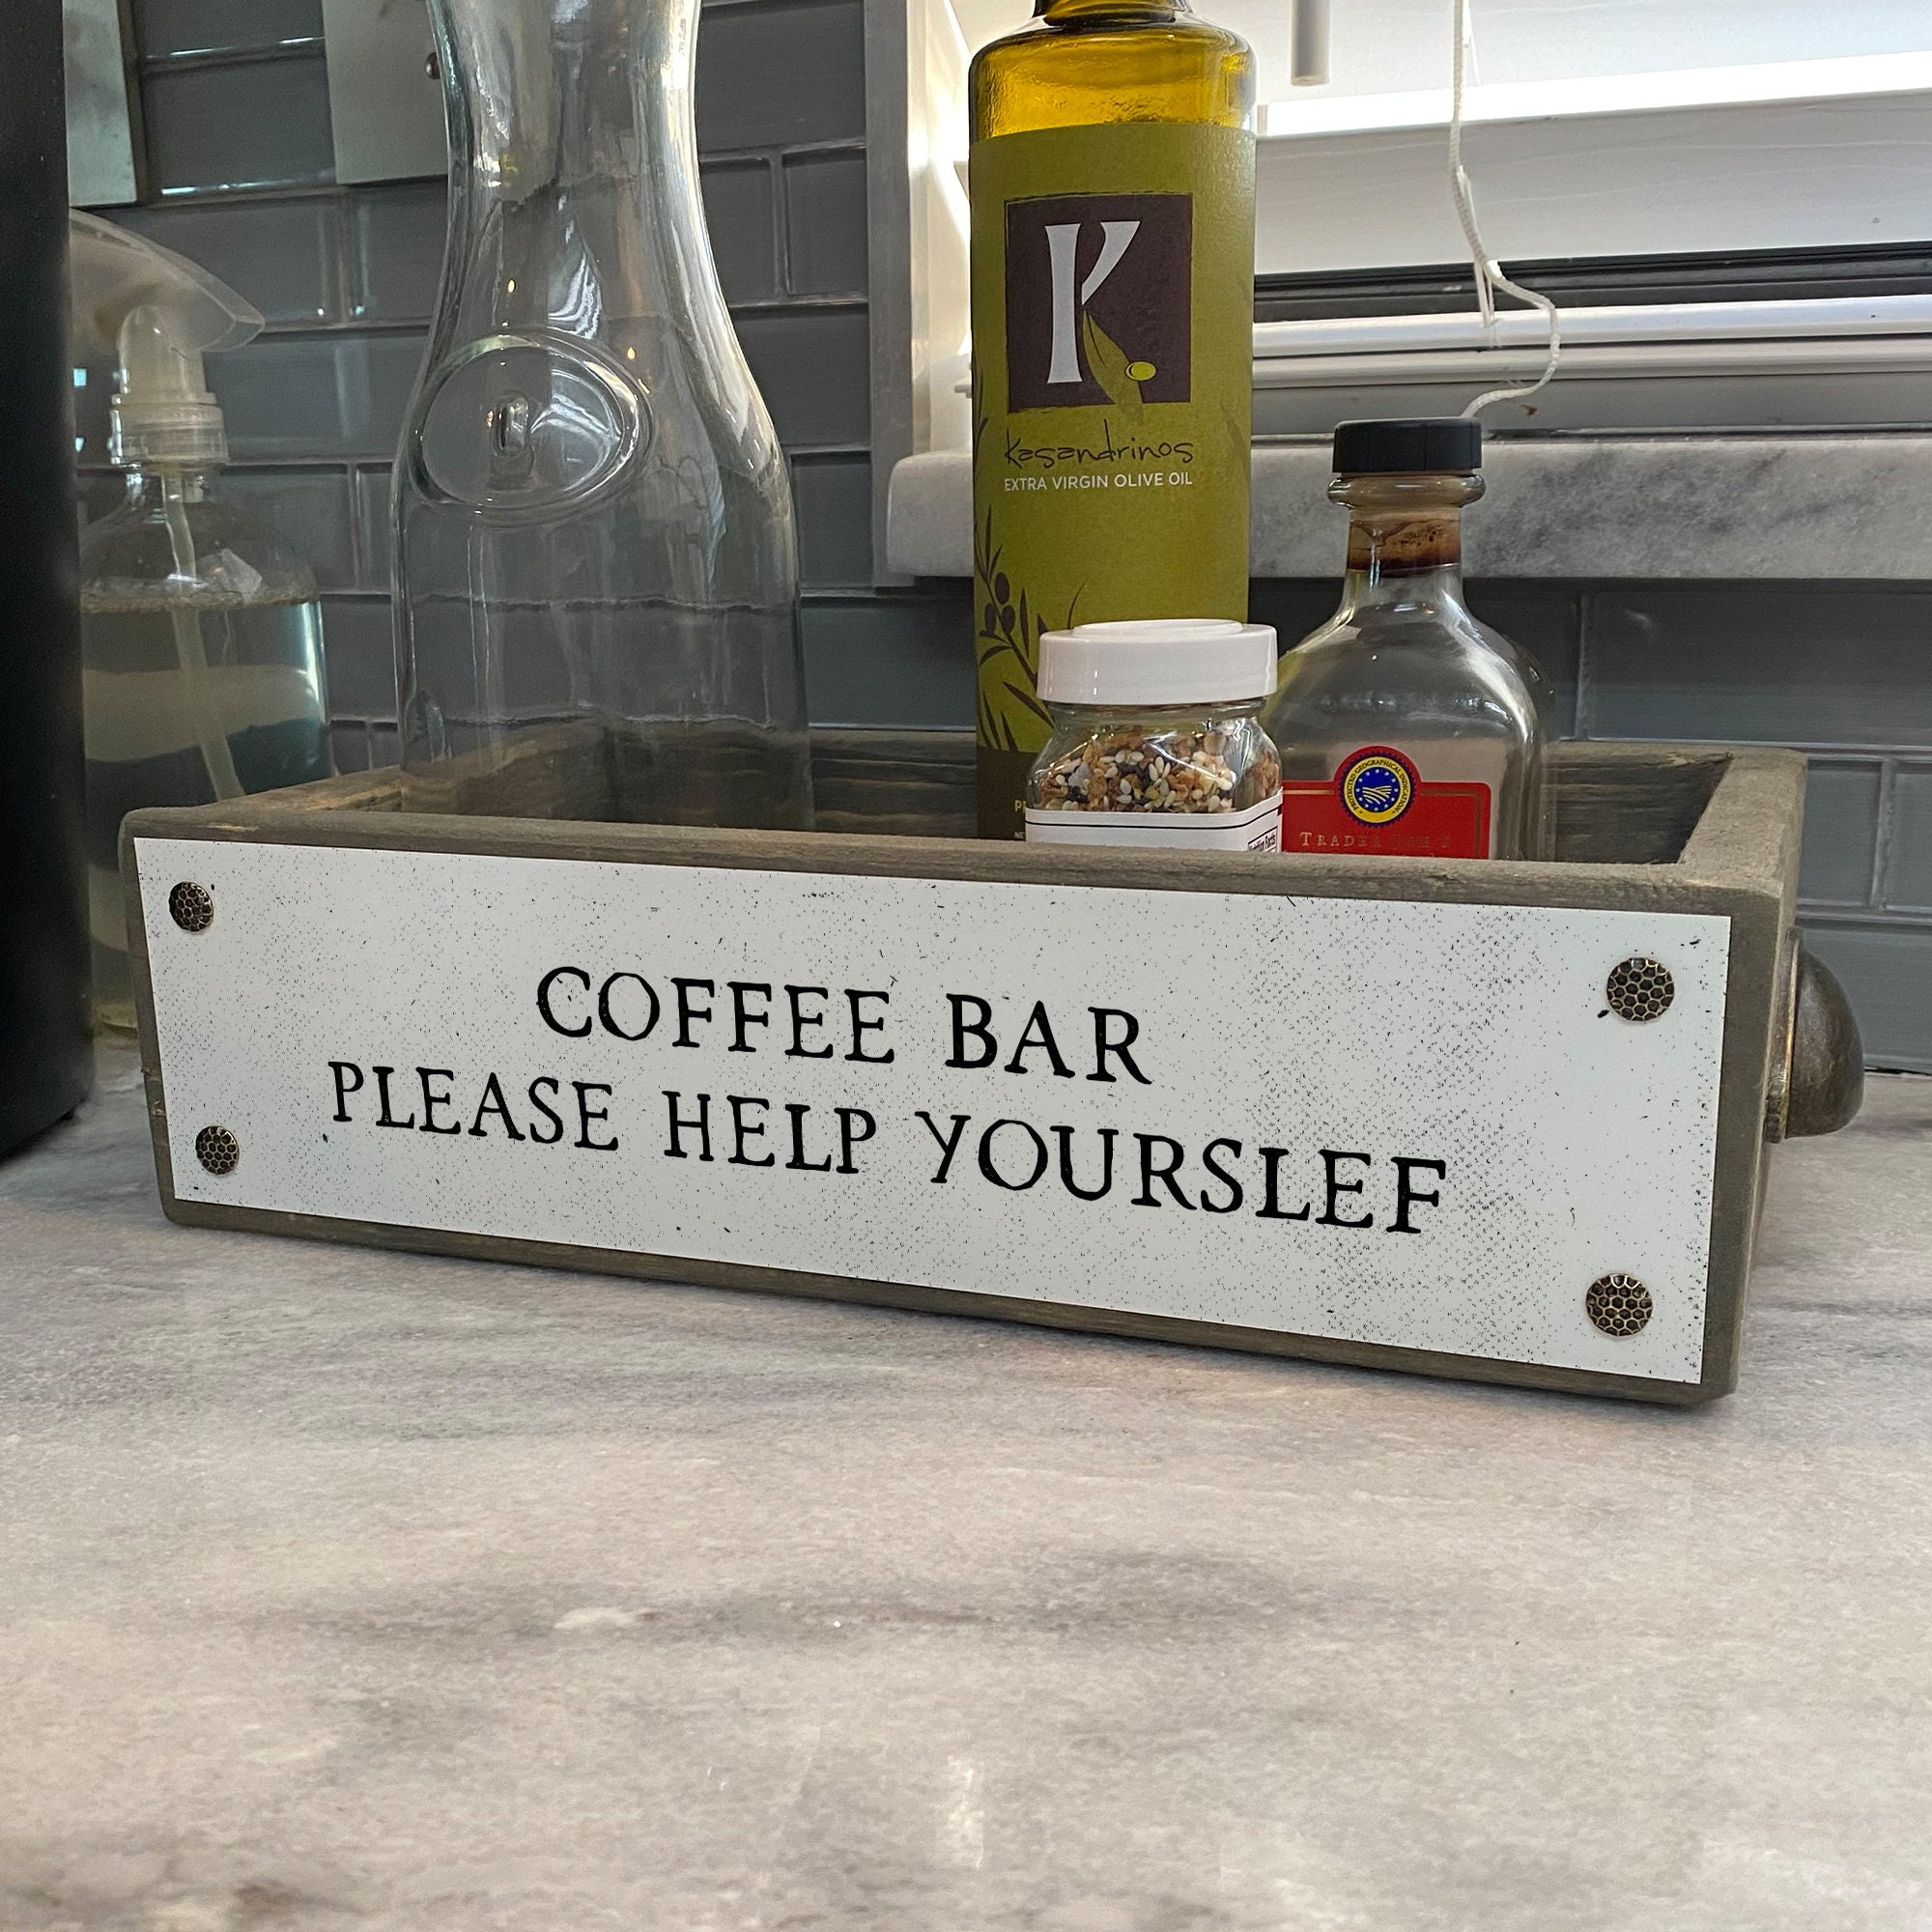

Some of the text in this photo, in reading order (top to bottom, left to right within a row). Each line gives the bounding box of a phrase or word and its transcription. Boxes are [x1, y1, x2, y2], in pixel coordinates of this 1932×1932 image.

[1005, 471, 1193, 492] EXTRA VIRGIN OLIVE OIL
[536, 967, 1153, 1085] COFFEE BAR
[328, 1062, 1447, 1235] PLEASE HELP YOURSLEF
